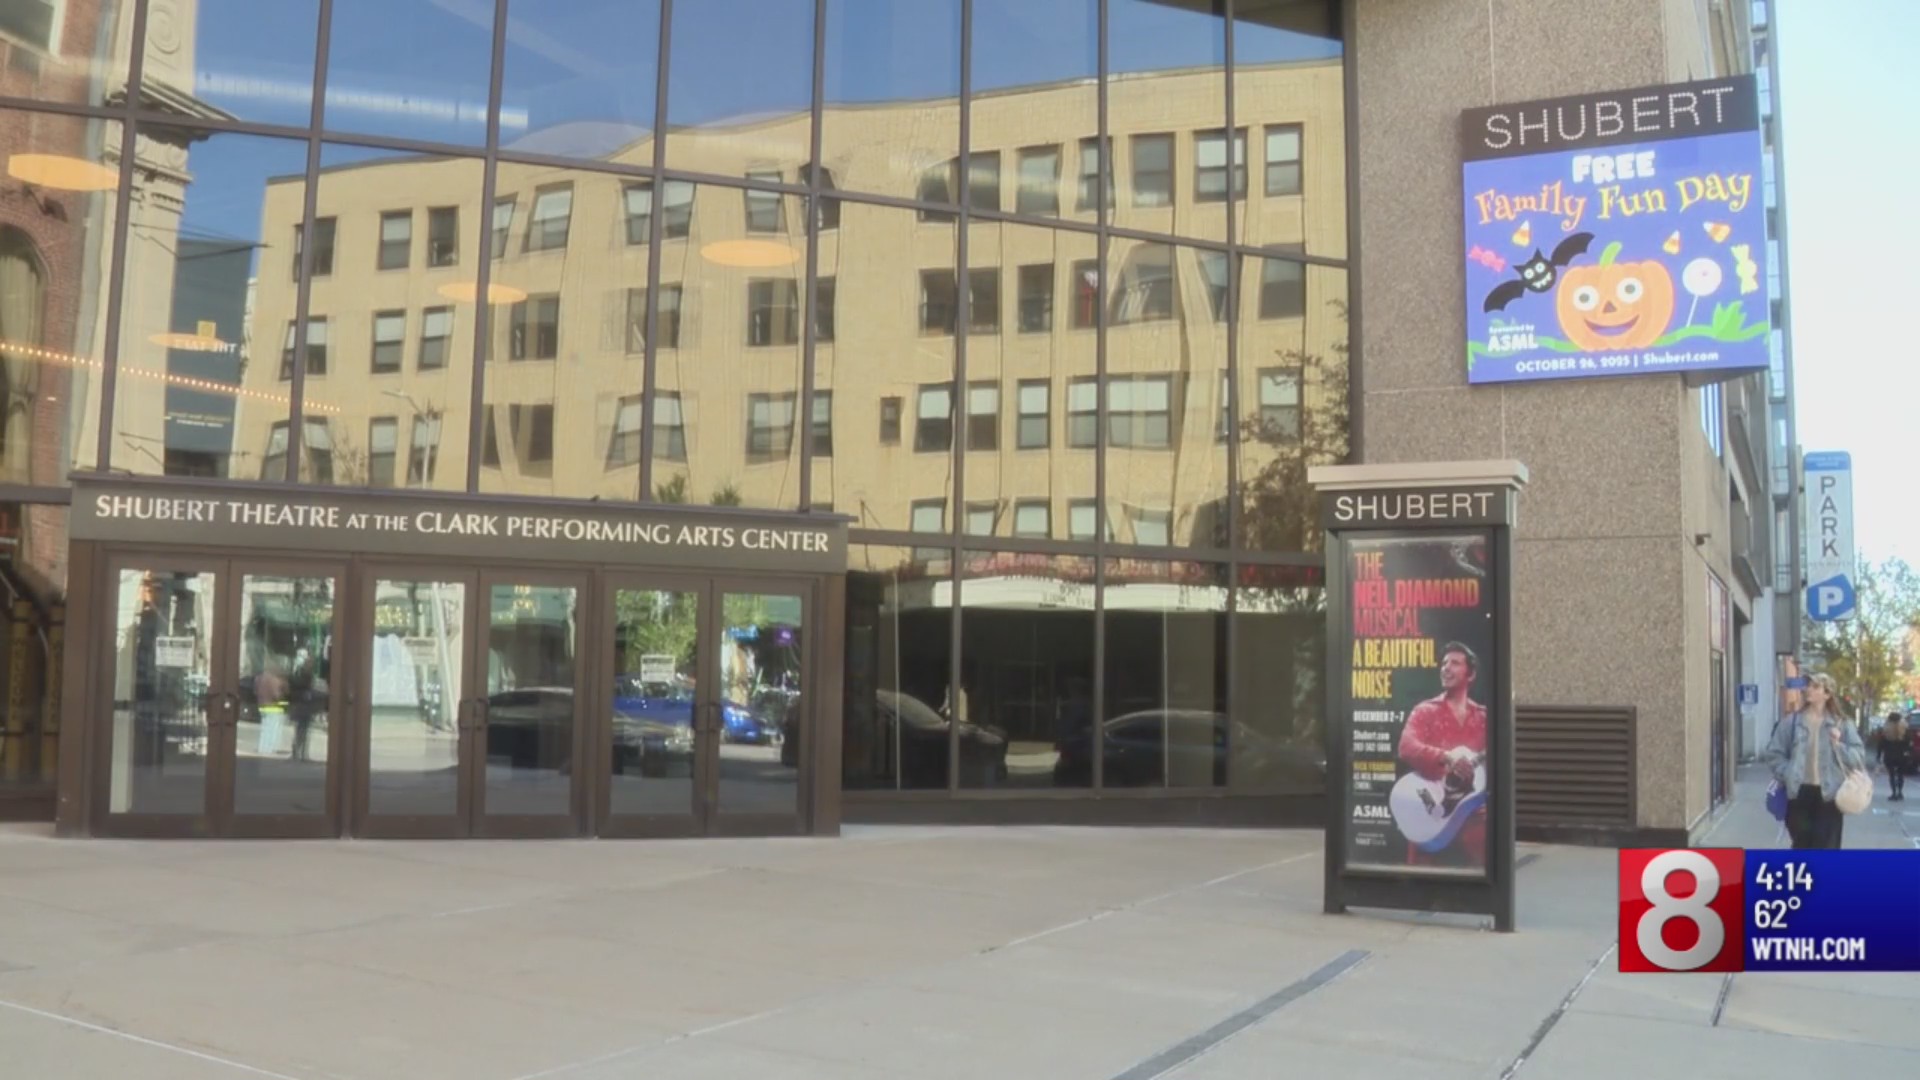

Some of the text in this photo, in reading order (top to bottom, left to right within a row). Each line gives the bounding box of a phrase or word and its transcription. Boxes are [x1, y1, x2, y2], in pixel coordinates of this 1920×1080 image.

[1485, 86, 1734, 149] SHUBERT
[1571, 150, 1656, 184] FREE
[1474, 172, 1752, 232] Family Fun Day
[1488, 332, 1539, 352] ASML
[1515, 357, 1576, 373] OCTOBER
[1643, 351, 1719, 366] Shubert.com
[1334, 492, 1494, 521] SHUBERT
[1820, 475, 1840, 558] PARK
[95, 495, 829, 553] SHUBERT THEATRE AT THE CLARK PERFORMING ARTS CENTER
[1354, 552, 1384, 579] THE
[1354, 578, 1479, 608] NEIL DIAMOND
[1818, 586, 1845, 616] P
[1354, 608, 1422, 636] MUSICAL
[1353, 638, 1437, 668] A BEAUTIFUL
[1352, 670, 1392, 698] NOISE
[1353, 711, 1389, 722] DECEMBER
[1353, 805, 1391, 818] ASML
